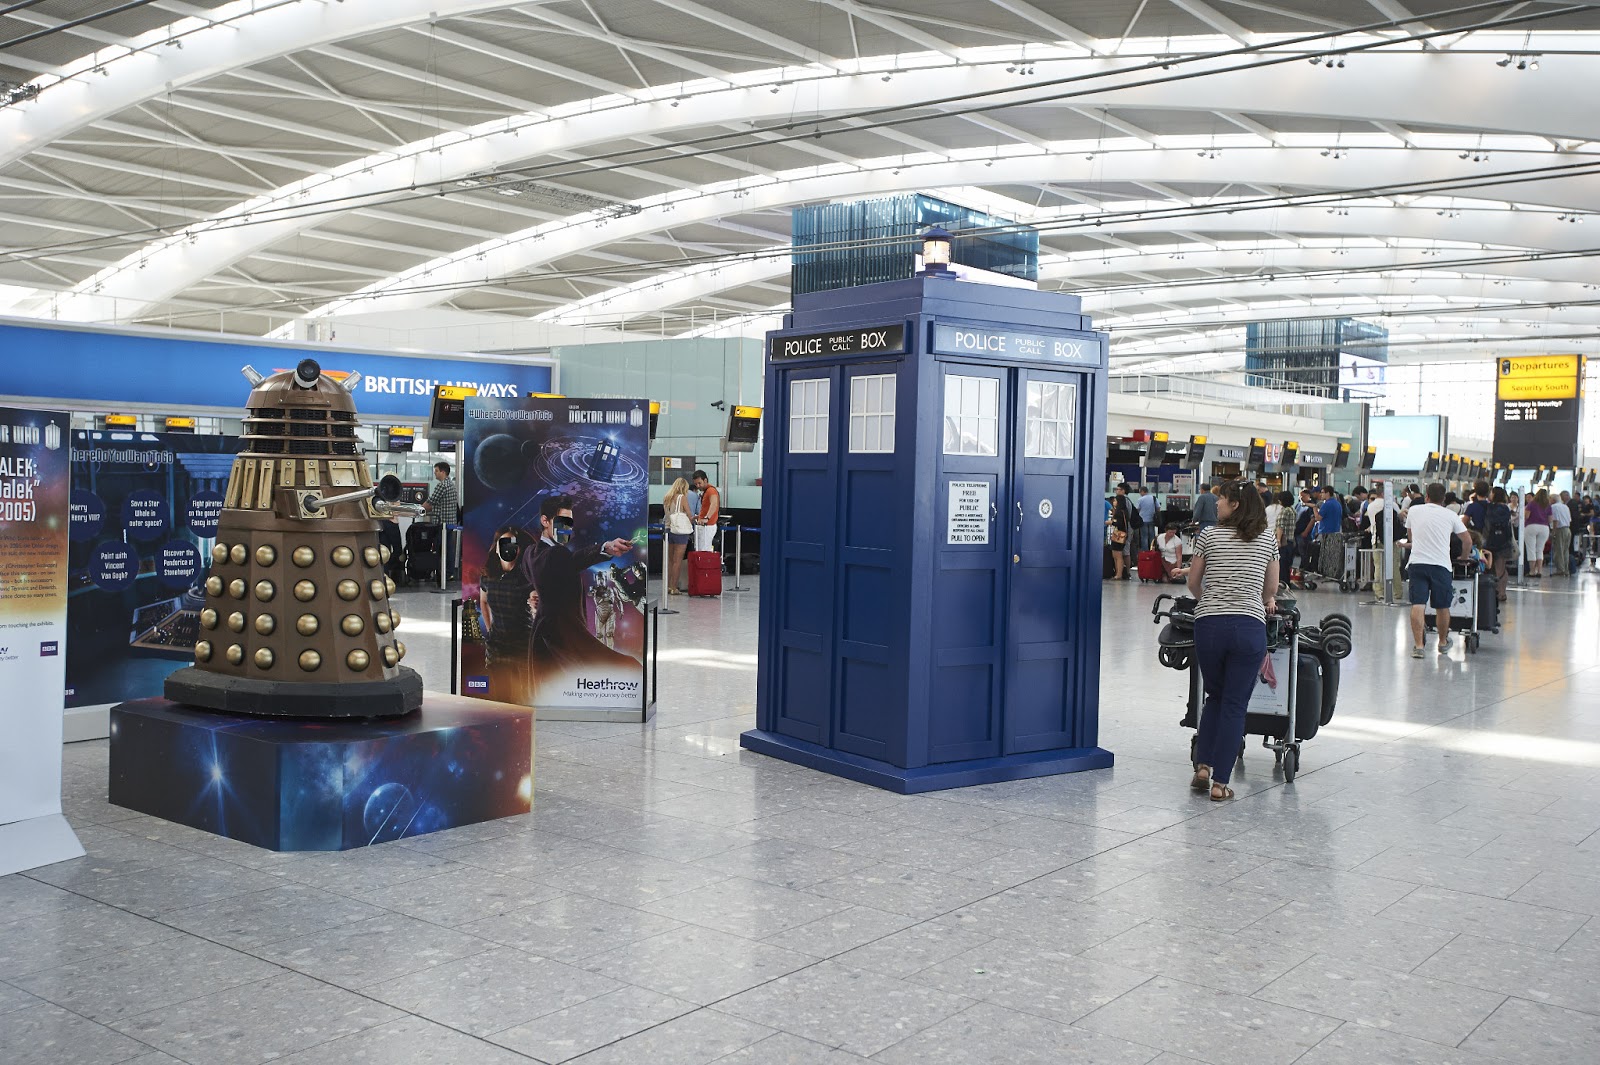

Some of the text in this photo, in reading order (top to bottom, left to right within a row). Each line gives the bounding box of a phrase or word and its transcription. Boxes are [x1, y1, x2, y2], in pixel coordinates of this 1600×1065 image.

[785, 331, 887, 356] POLICE PUBLIC BOX
[955, 332, 1082, 358] POLICE PUBLIC BOX
[1018, 346, 1042, 355] CALL
[1512, 361, 1570, 371] Departures
[365, 375, 436, 396] BRITISH
[1512, 383, 1570, 392] Security South
[469, 408, 554, 421] #WhereDoYouWantToGo
[568, 410, 603, 424] DOCTOR
[606, 411, 627, 425] WHO
[13, 425, 40, 445] WHO
[951, 534, 986, 542] PULL TO OPEN
[468, 680, 487, 688] BBC
[577, 678, 639, 691] Heathrow
[562, 691, 583, 699] Making
